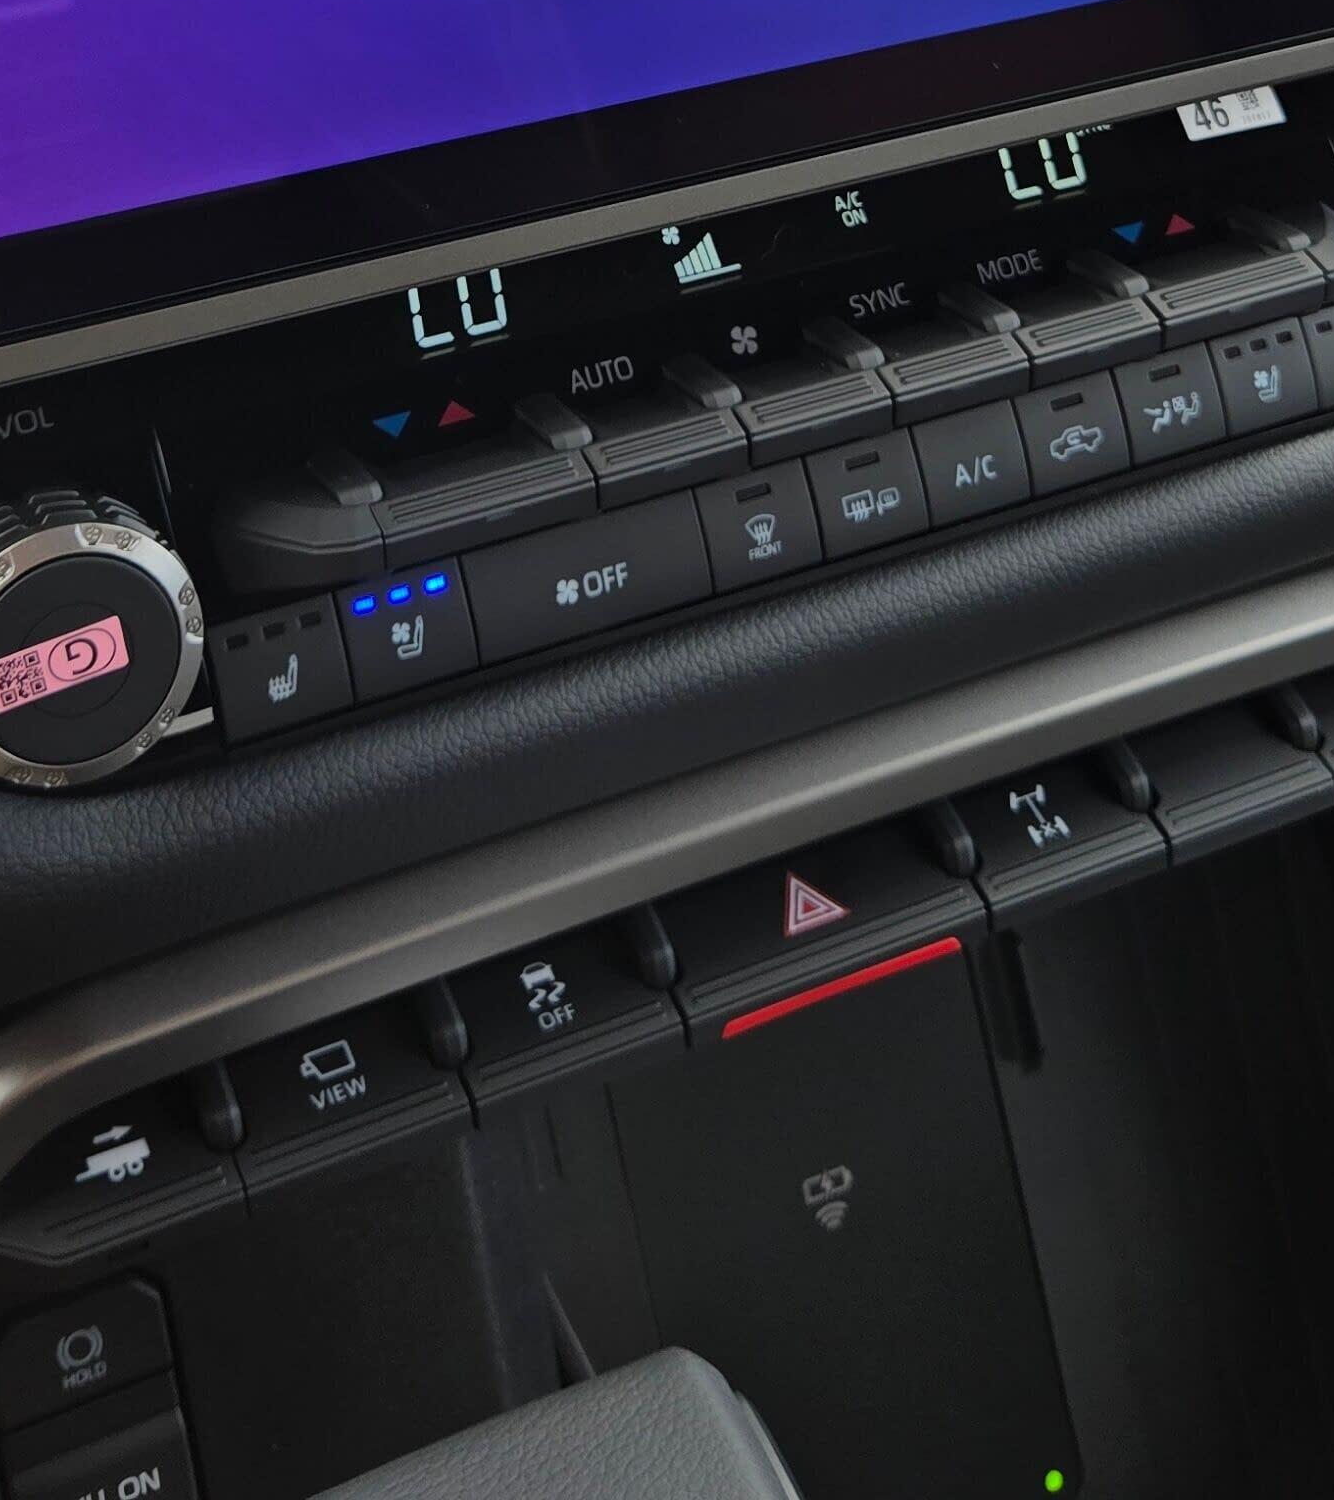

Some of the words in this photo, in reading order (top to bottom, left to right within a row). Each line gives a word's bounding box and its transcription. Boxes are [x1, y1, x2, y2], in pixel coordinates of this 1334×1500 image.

[1194, 98, 1230, 130] 46
[834, 190, 863, 212] A/C
[841, 208, 868, 228] ON
[976, 248, 1043, 285] MODE
[848, 282, 910, 318] SYNC
[571, 355, 635, 394] AUTO
[955, 454, 997, 487] A/C
[748, 540, 782, 561] FRONT
[582, 561, 629, 598] OFF
[537, 1003, 576, 1031] OFF
[309, 1075, 367, 1111] VIEW
[117, 1467, 161, 1500] ON
